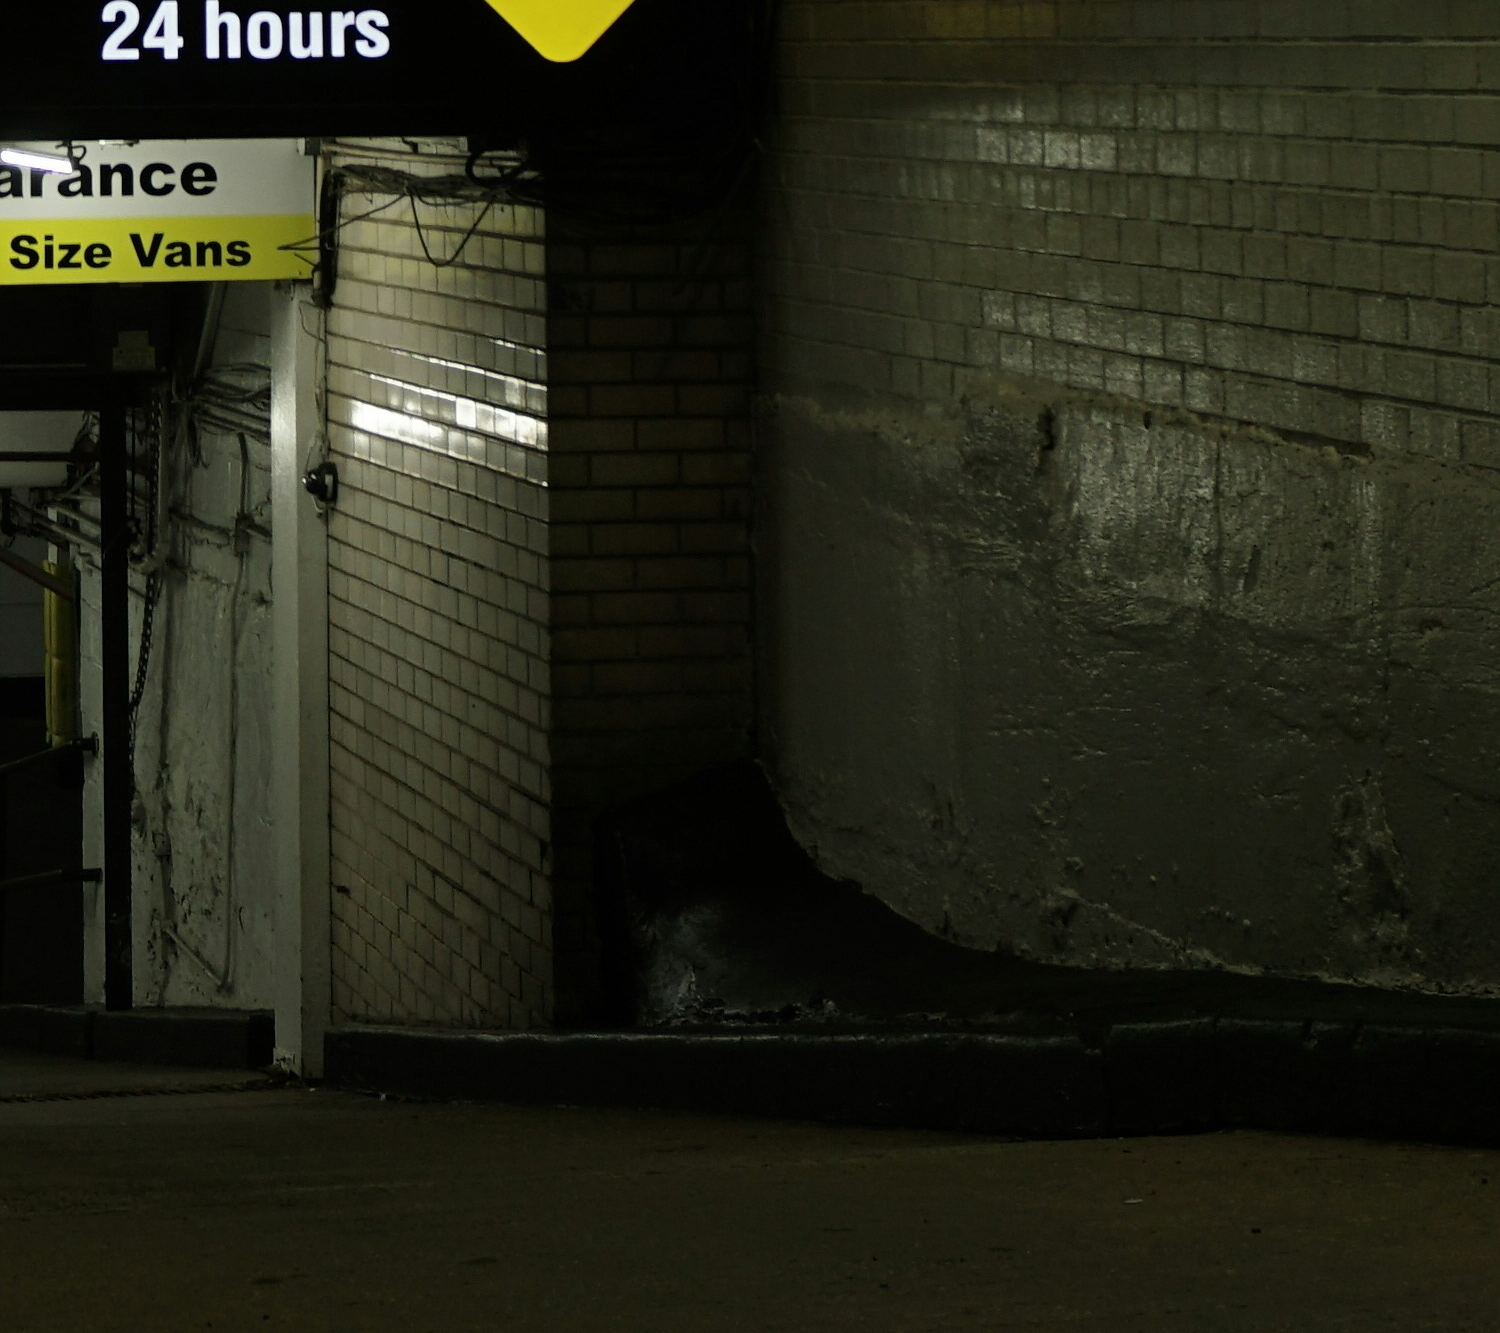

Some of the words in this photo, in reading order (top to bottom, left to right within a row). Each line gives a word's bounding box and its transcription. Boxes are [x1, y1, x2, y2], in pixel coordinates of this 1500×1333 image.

[102, 0, 183, 60] 24
[206, 0, 389, 59] hours
[10, 235, 111, 269] Size
[130, 233, 251, 267] Vans
